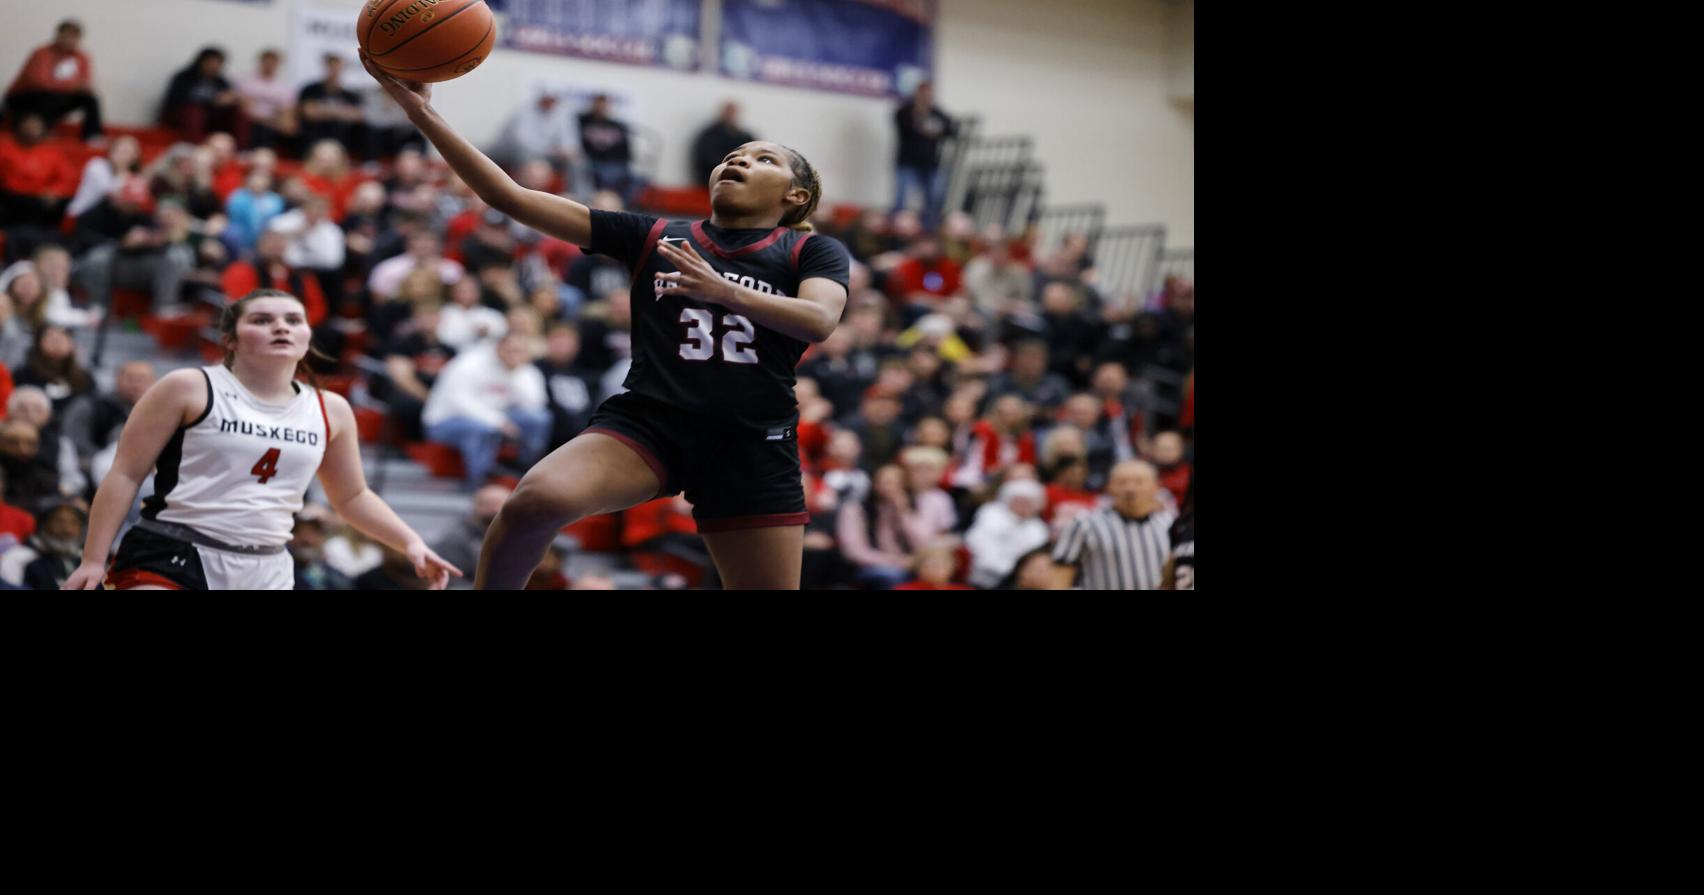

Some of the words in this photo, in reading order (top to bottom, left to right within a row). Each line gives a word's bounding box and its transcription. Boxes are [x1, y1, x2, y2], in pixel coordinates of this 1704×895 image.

[679, 307, 759, 364] 32
[220, 418, 318, 446] MUSKEGO
[250, 447, 281, 485] 4
